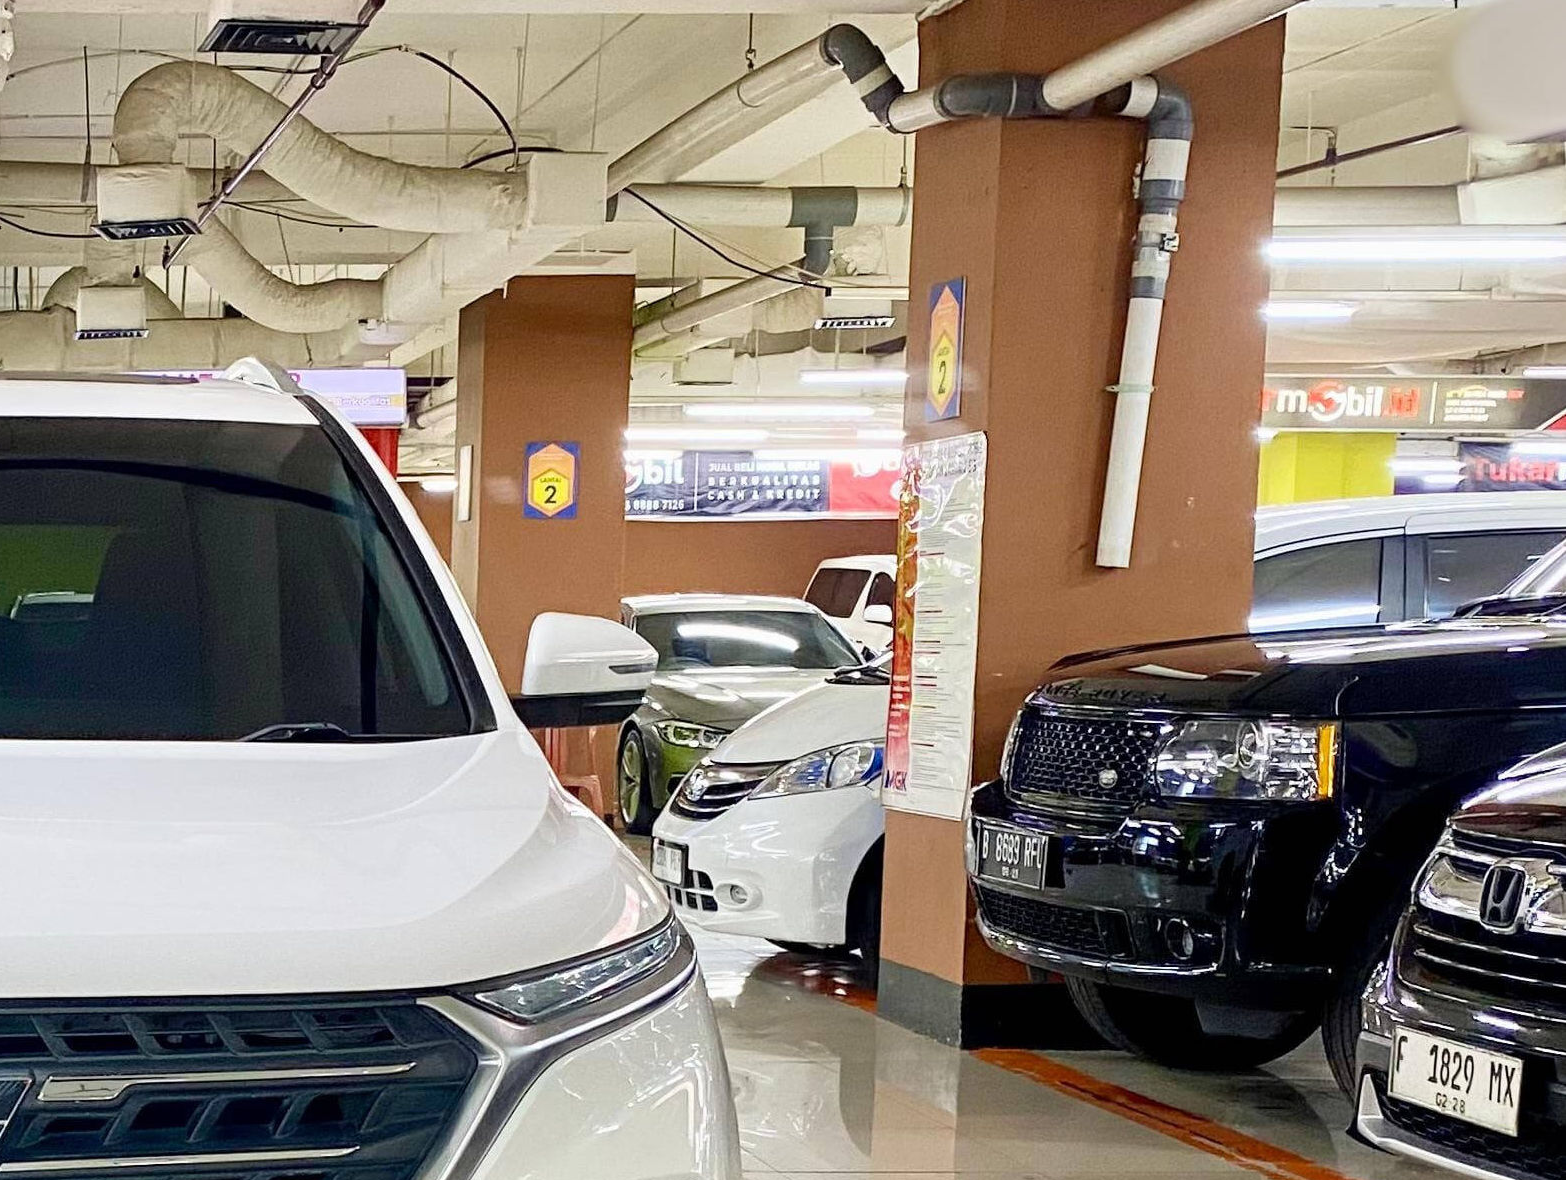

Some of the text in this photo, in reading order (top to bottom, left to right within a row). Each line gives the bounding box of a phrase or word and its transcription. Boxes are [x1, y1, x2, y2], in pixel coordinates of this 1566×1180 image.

[938, 360, 947, 395] 2
[707, 474, 821, 487] BERKUALITAS
[544, 485, 557, 504] 2
[707, 488, 745, 501] CASH
[766, 487, 822, 500] KREDIT
[982, 830, 990, 859] B
[1396, 1035, 1516, 1109] F 1829 MX
